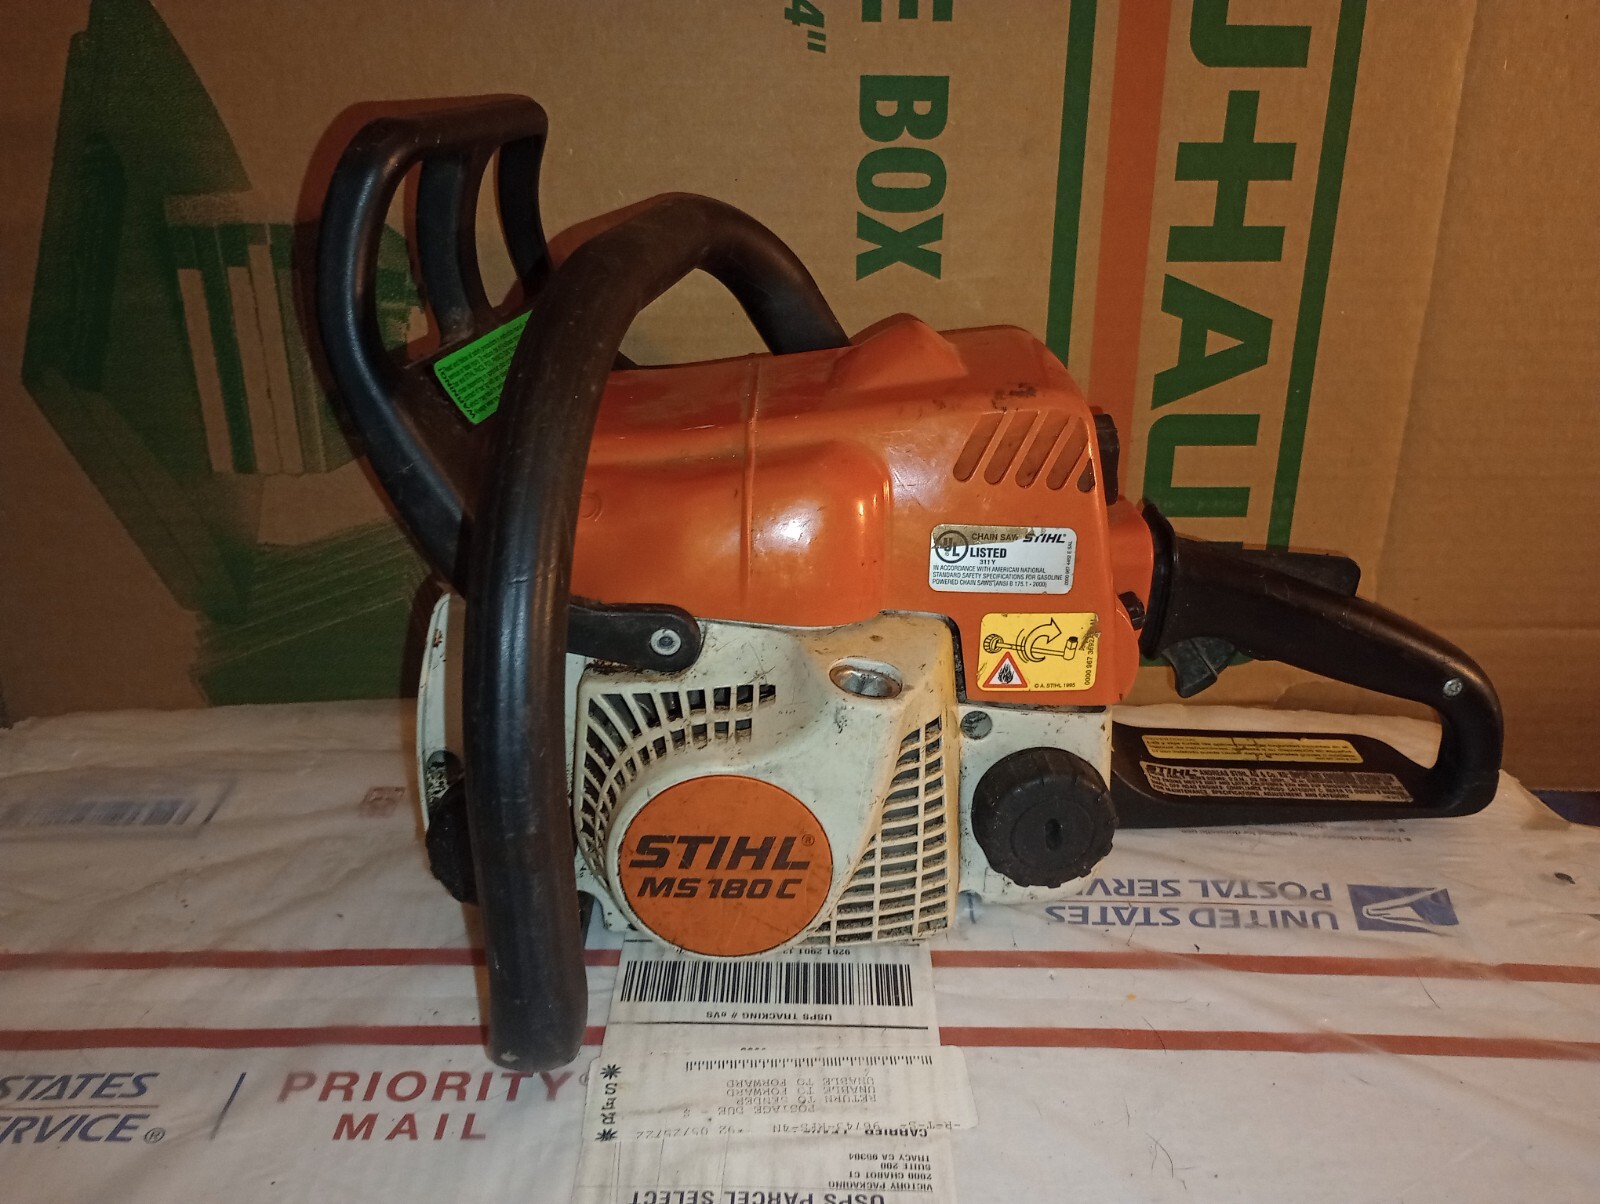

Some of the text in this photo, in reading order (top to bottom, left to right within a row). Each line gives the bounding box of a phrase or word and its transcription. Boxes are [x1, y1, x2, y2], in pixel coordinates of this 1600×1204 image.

[856, 74, 949, 280] BOX
[1142, 0, 1312, 517] U-HAU
[971, 532, 998, 541] CHAIN
[1022, 533, 1065, 544] STIHL
[969, 547, 1007, 559] LISTED
[1086, 656, 1094, 669] 967
[1084, 669, 1092, 685] 0000
[637, 877, 803, 899] MS 180 C
[1076, 878, 1332, 900] POSTAL SERV
[1045, 904, 1340, 931] UNITED STATES
[742, 1012, 798, 1021] TRACKING
[802, 1013, 832, 1021] USPS
[0, 1072, 160, 1100] STATES
[278, 1070, 575, 1101] PRIORITY
[726, 1077, 875, 1087] UNABLE TO FORWARD
[726, 1086, 877, 1096] UNABLE TO FORWARD
[797, 1095, 816, 1104] TO
[824, 1094, 877, 1103] RETURN
[717, 1106, 744, 1116] DUE
[332, 1112, 487, 1141] MAIL
[899, 1154, 930, 1162] TRACY
[880, 1162, 898, 1170] 200
[828, 1180, 933, 1191] VICTORY PACKAGING
[630, 1190, 885, 1204] USPS PARCEL SELECT
